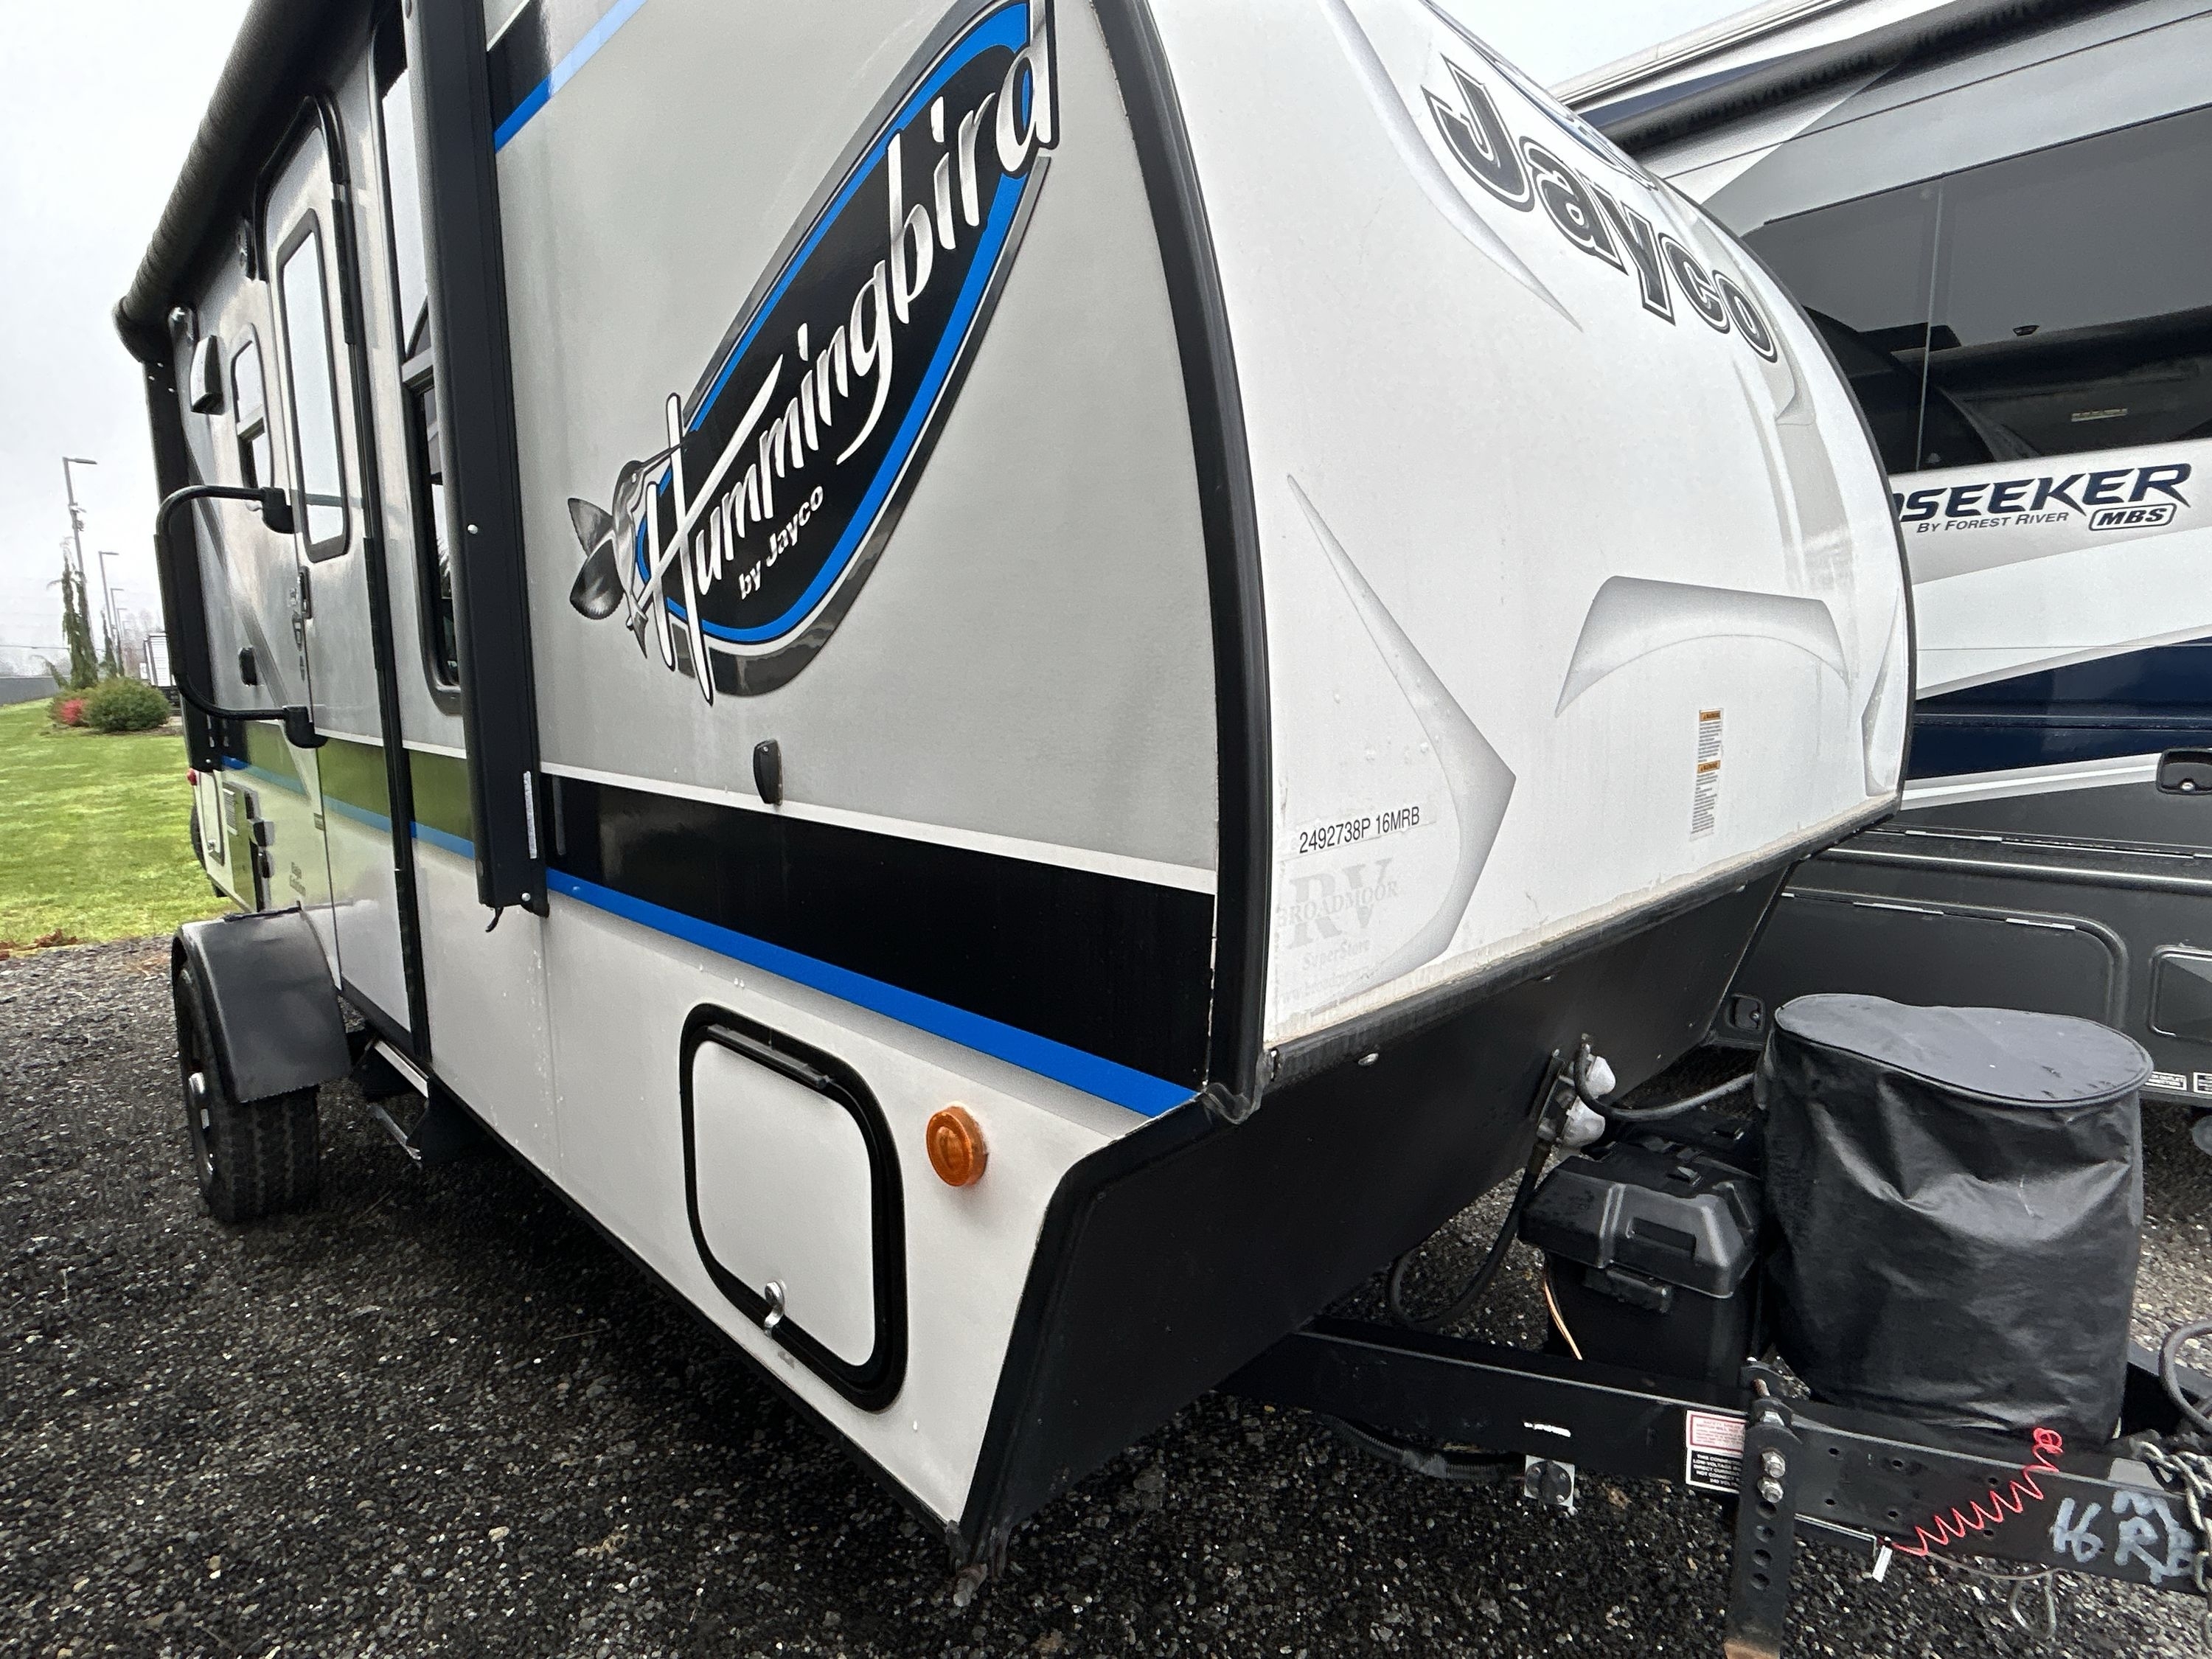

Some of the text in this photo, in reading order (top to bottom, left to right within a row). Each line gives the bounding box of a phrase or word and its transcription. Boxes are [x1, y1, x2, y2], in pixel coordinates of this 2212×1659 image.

[1421, 52, 1778, 364] Jayco
[626, 0, 1057, 704] Hummingbird
[739, 485, 824, 600] by Jayco
[2096, 507, 2168, 526] MBS
[1299, 806, 1420, 854] 2492738P 16MRB
[1287, 858, 1394, 950] RV
[2049, 1497, 2104, 1563] 16
